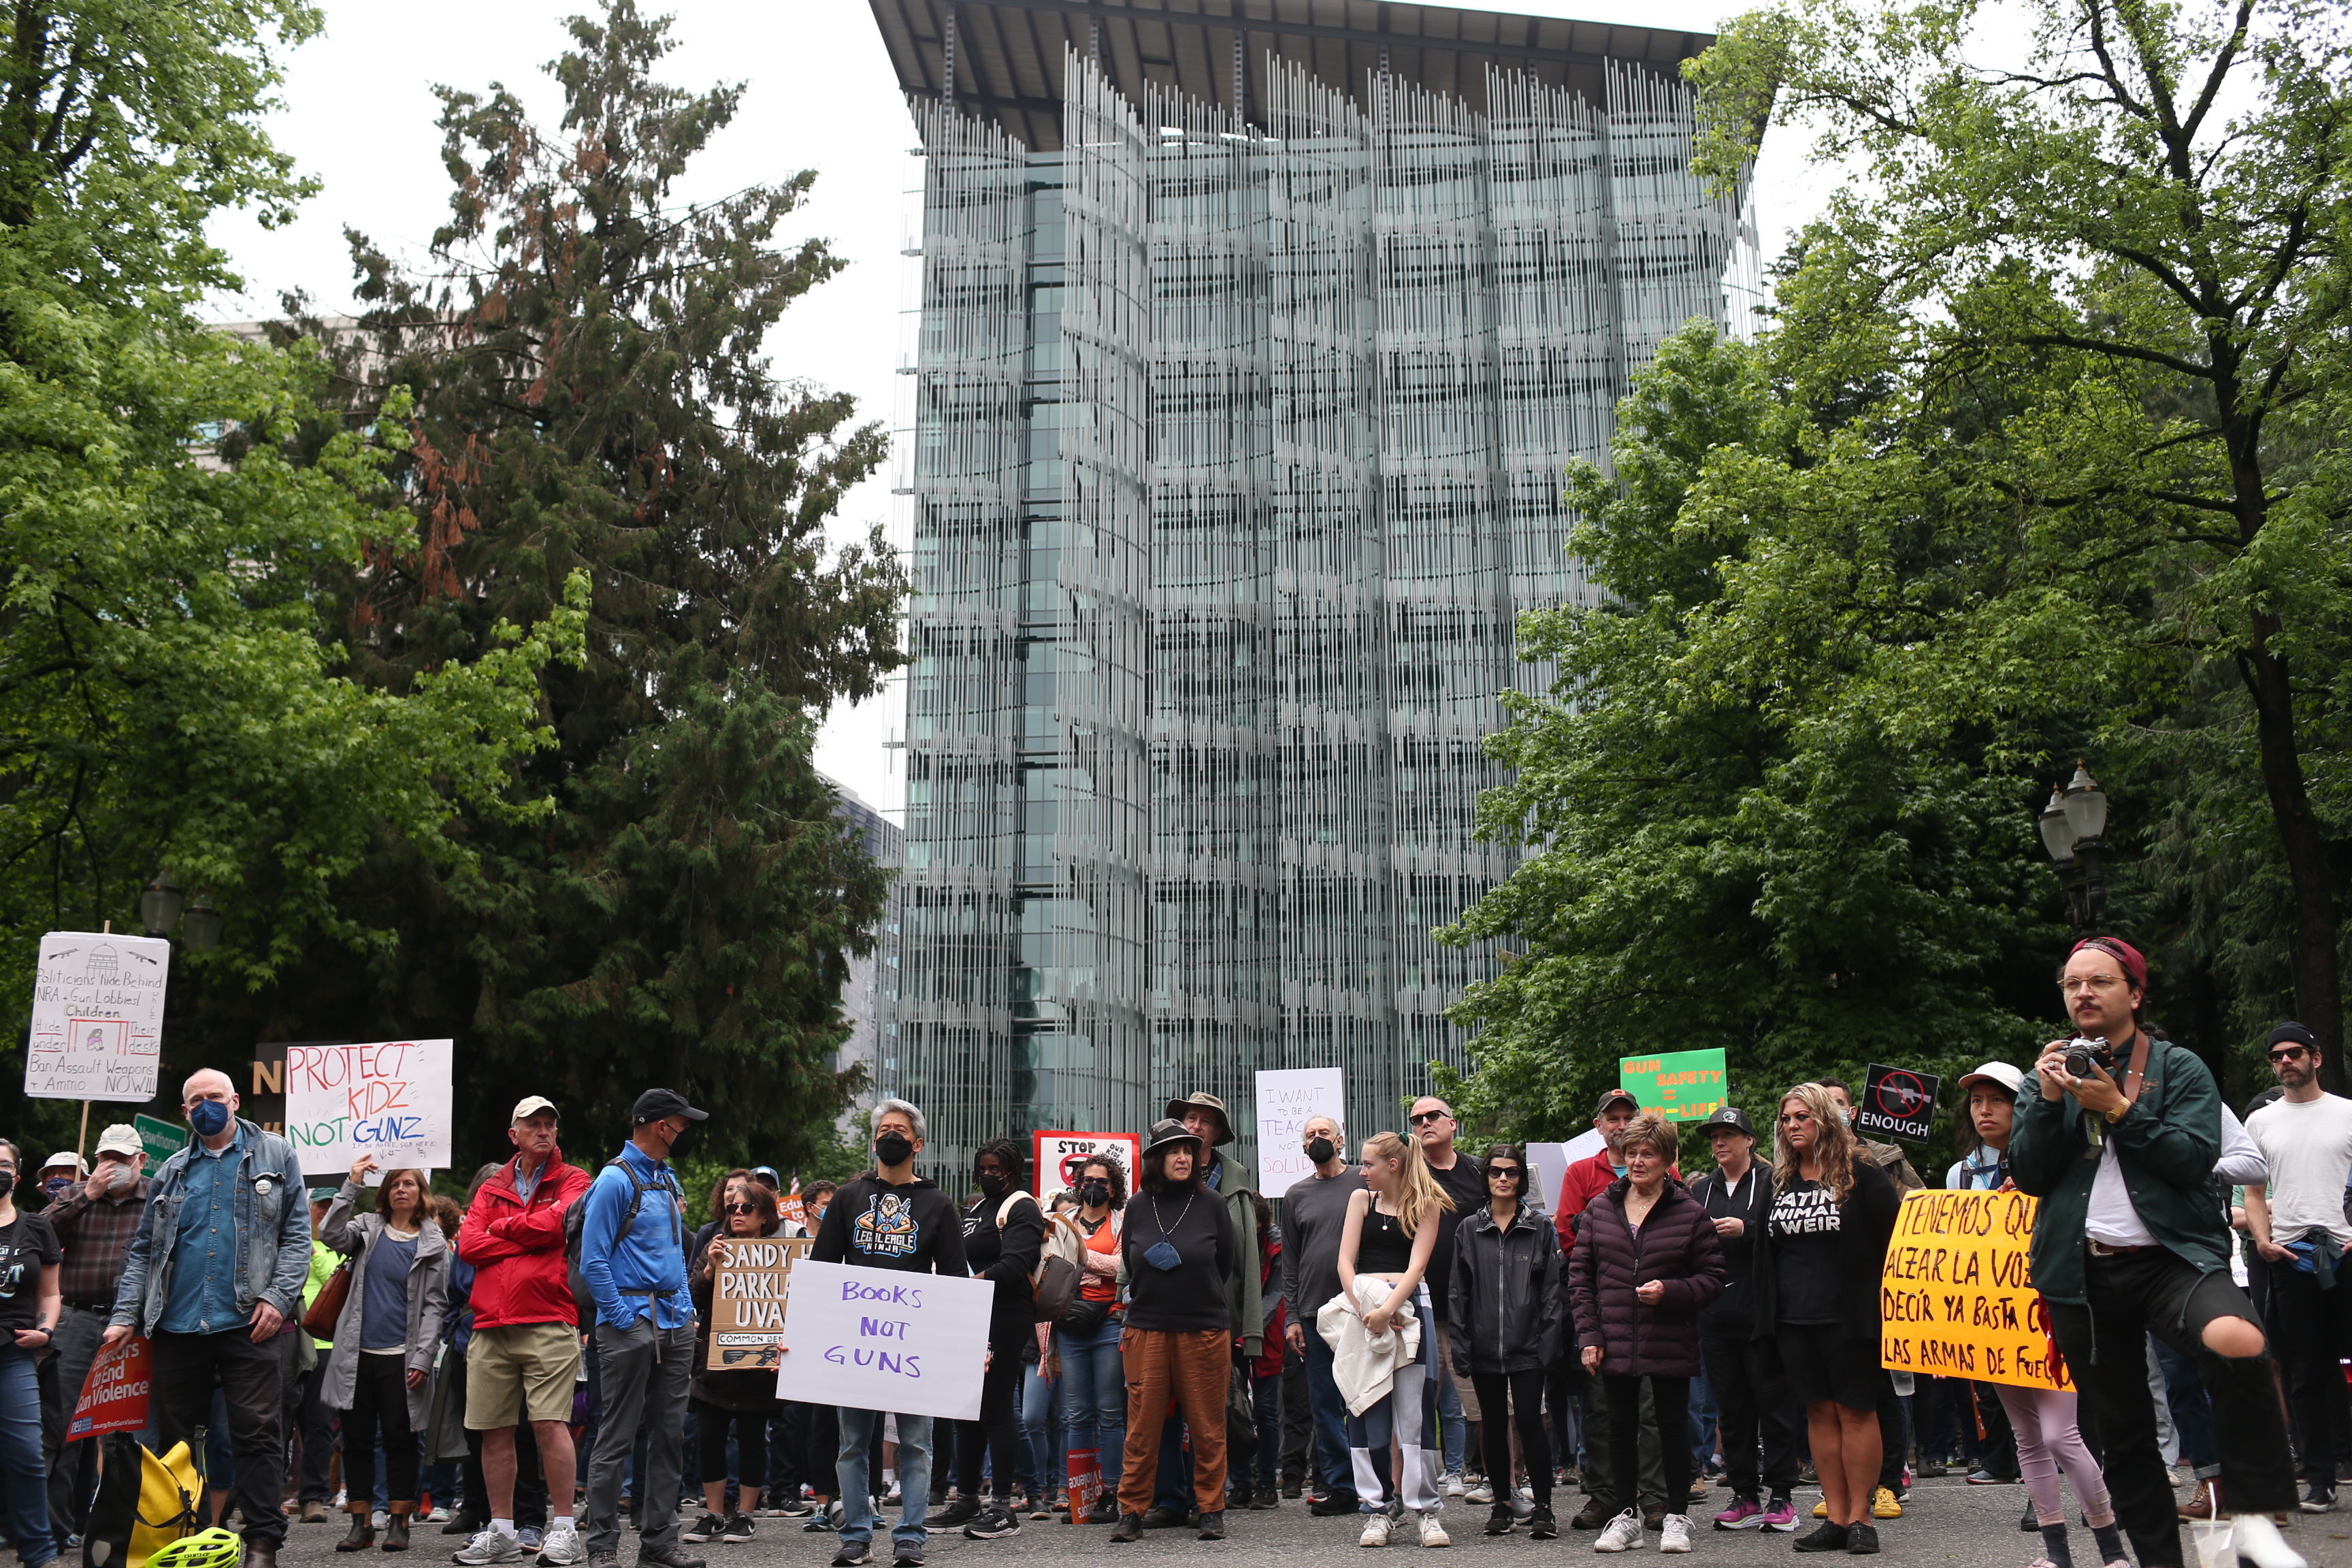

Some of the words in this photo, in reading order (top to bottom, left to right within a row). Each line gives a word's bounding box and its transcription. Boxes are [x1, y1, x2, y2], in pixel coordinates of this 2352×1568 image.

[37, 968, 95, 984] Politicians
[100, 974, 120, 986] hide
[122, 971, 163, 988] Behind
[36, 986, 59, 1002] NRA
[71, 987, 91, 1002] Gun
[95, 988, 141, 1006] Lobbies!
[65, 1004, 121, 1019] Children
[36, 1018, 61, 1031] Hide
[130, 1021, 157, 1034] Their
[33, 1036, 66, 1049] under
[29, 1054, 51, 1072] Ban
[55, 1056, 101, 1074] Assault
[107, 1059, 154, 1077] Weapons
[289, 1043, 415, 1094] PROTECT
[1623, 1059, 1661, 1074] GUN
[44, 1077, 86, 1090] Ammo
[105, 1075, 155, 1094] NOW!!!
[253, 1060, 287, 1094] N
[1656, 1070, 1722, 1087] SAFETY
[348, 1081, 409, 1121] KIDZ
[1265, 1090, 1275, 1103] I
[1279, 1088, 1324, 1103] WANT
[1306, 1106, 1313, 1114] A
[289, 1116, 349, 1149] NOT
[353, 1116, 425, 1143] GUNZ
[1260, 1120, 1303, 1136] TEAC
[1861, 1111, 1929, 1137] ENOUGH
[139, 1125, 181, 1152] Hawthorne
[1058, 1141, 1096, 1154] STOP
[1279, 1141, 1298, 1150] NOT
[1563, 1141, 1585, 1154] The
[1585, 1132, 1601, 1145] NR
[1106, 1148, 1120, 1158] KIDS
[1109, 1143, 1124, 1154] OUR
[1264, 1157, 1316, 1173] SOLID
[791, 1211, 804, 1220] to
[1769, 1204, 1840, 1221] NIMAL
[1902, 1194, 1998, 1237] TENEMOS
[2006, 1195, 2037, 1241] QU
[1780, 1216, 1840, 1235] WEIR
[721, 1243, 791, 1268] SANDY
[800, 1244, 813, 1259] H
[866, 1243, 898, 1253] NINJA
[1884, 1247, 1946, 1281] ALZAR
[1953, 1250, 1979, 1286] LA
[842, 1281, 923, 1308] BOOKS
[735, 1301, 785, 1328] UVA
[1944, 1295, 1964, 1322] YA
[860, 1317, 911, 1340] NOT
[719, 1335, 763, 1343] COMMON
[768, 1334, 784, 1343] DEN
[824, 1345, 921, 1377] GUNS
[1884, 1337, 1911, 1365] LAS
[1921, 1339, 1975, 1371] ARMAS
[1987, 1347, 2006, 1375] DE
[92, 1371, 101, 1388] to
[102, 1360, 125, 1384] End
[76, 1394, 91, 1415] Gun
[93, 1380, 149, 1407] Violence
[1068, 1471, 1098, 1489] Violence
